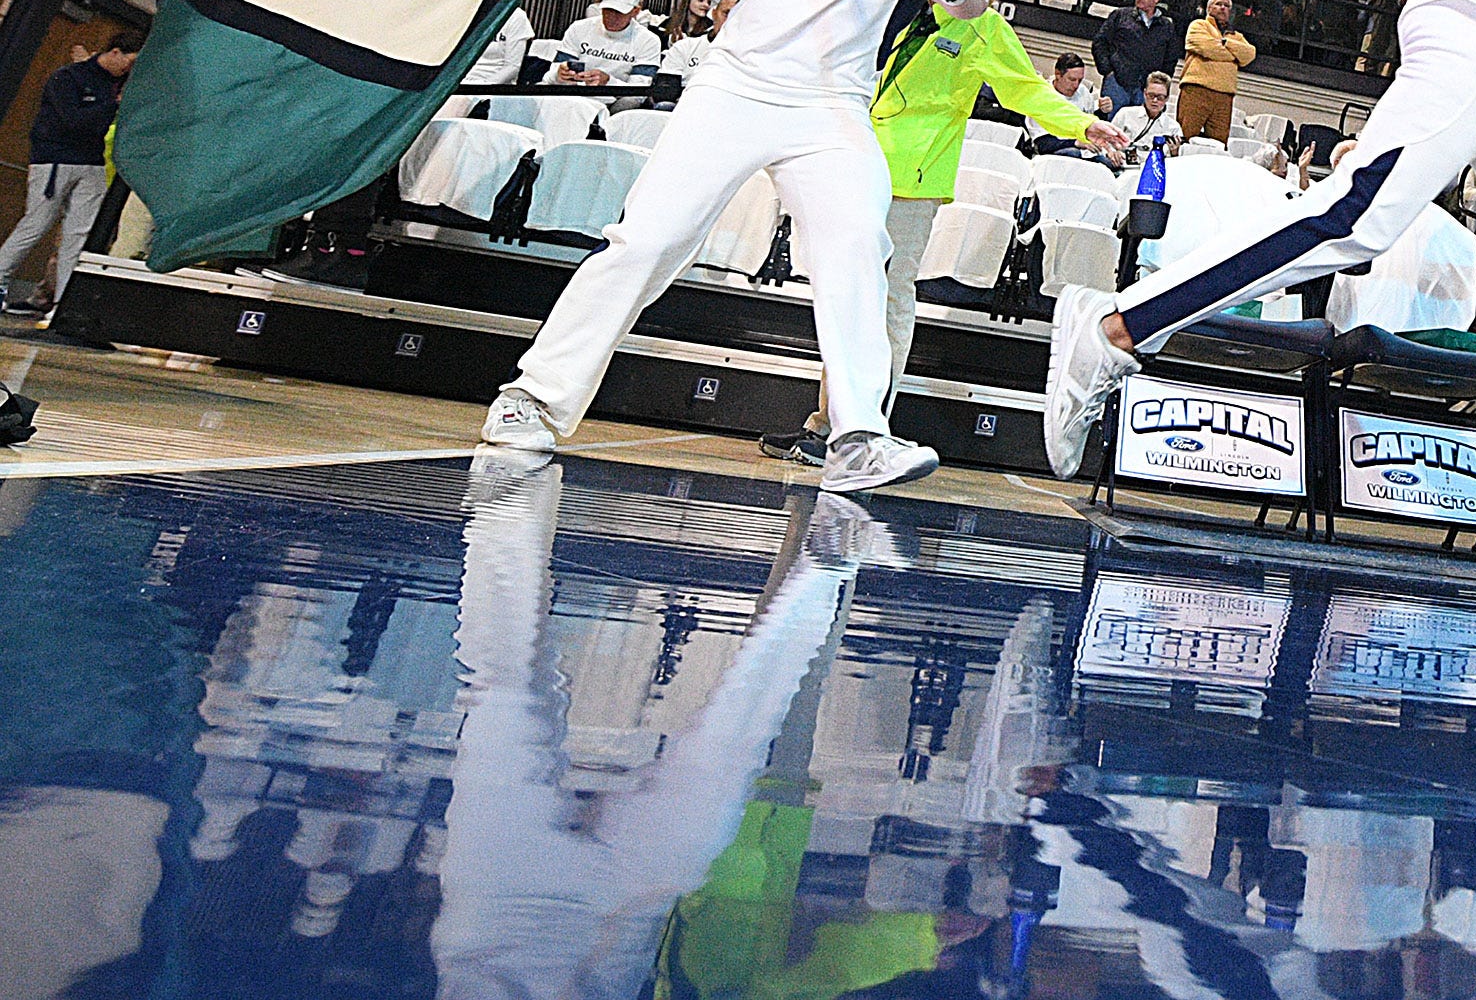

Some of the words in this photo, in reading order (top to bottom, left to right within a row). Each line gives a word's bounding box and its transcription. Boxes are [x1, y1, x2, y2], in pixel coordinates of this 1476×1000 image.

[579, 42, 636, 64] Seahawks
[1131, 398, 1294, 456] CAPITAL
[1146, 450, 1282, 480] WILMINGTON
